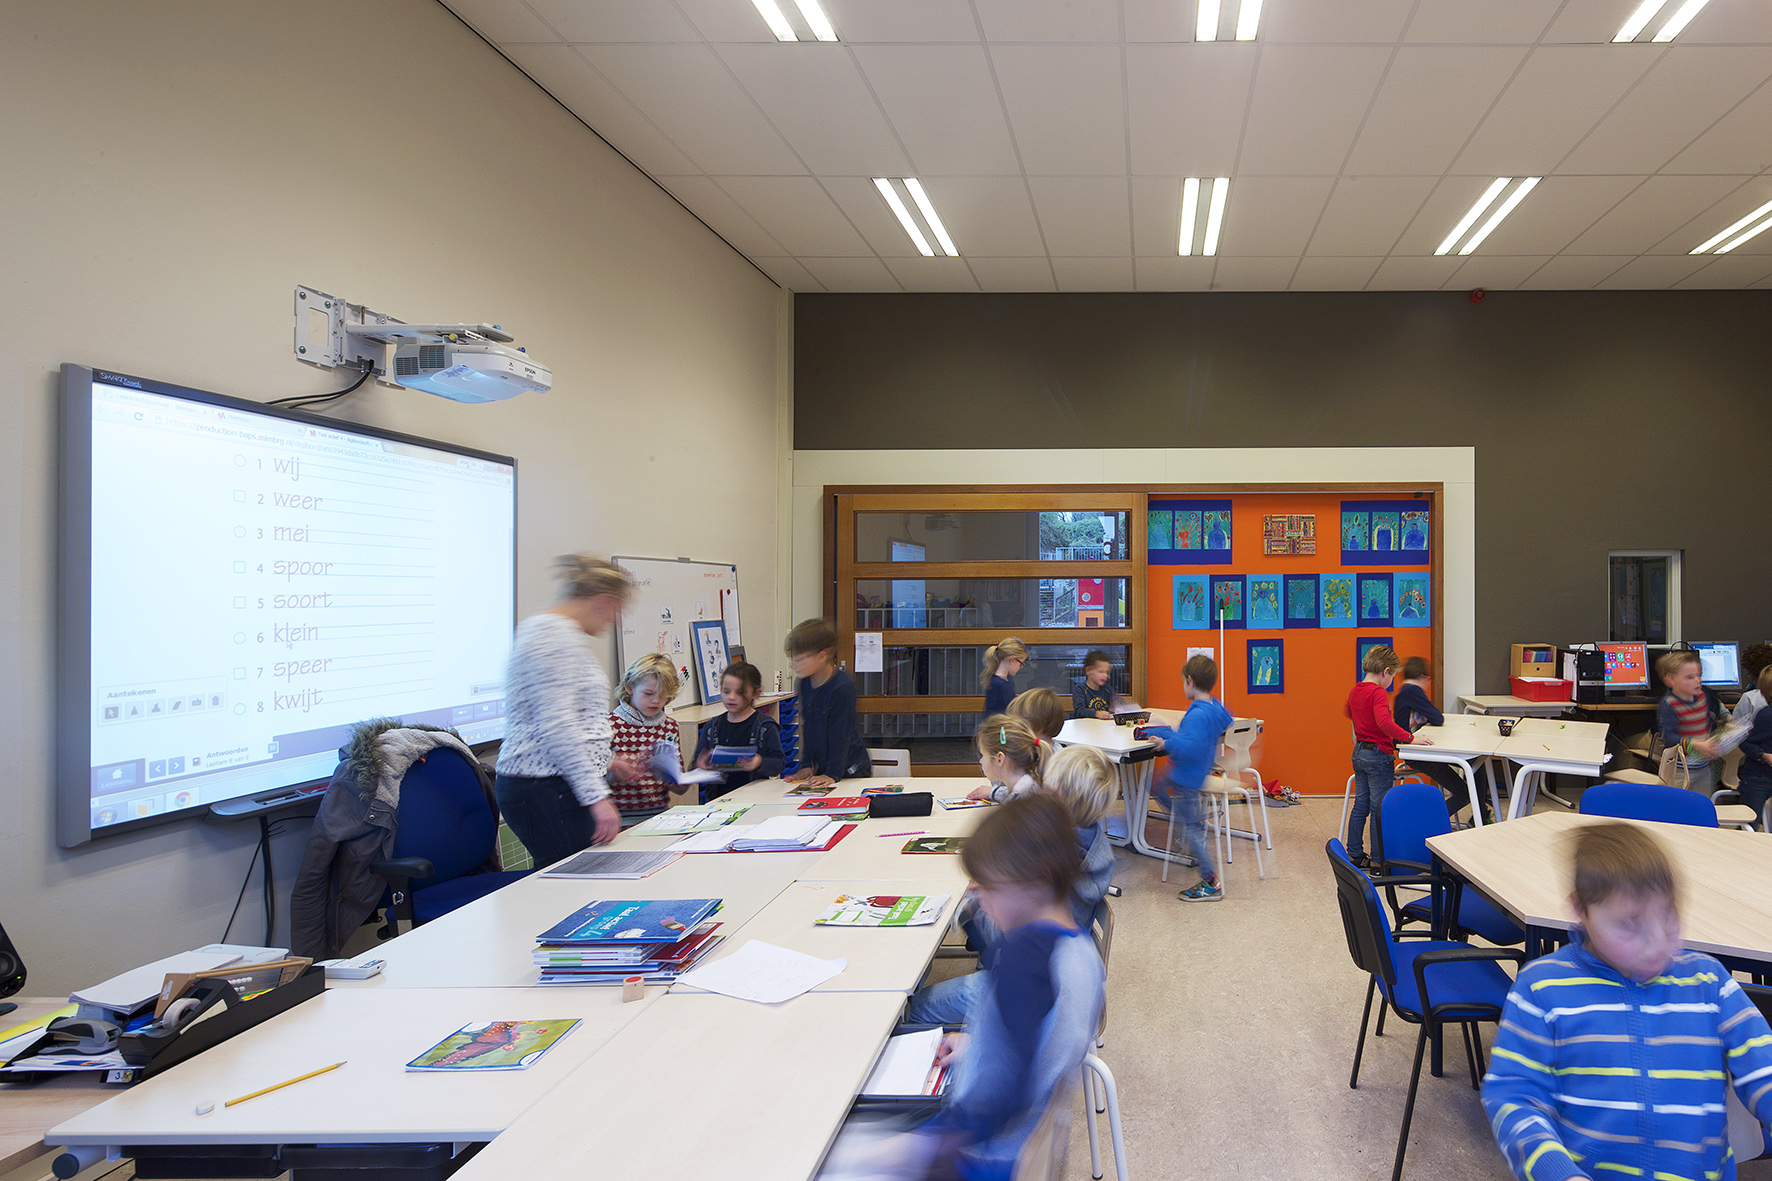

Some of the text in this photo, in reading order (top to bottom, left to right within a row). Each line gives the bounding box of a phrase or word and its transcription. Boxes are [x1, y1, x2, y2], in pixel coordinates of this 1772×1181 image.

[524, 366, 536, 375] EPSON
[256, 456, 300, 482] 1 wij
[257, 491, 323, 510] 2 weer
[256, 524, 309, 542] 3 mei
[256, 560, 333, 583] 4 spoor
[257, 591, 333, 609] 5 soort
[256, 622, 319, 643] 6 klein
[256, 659, 333, 683] 7 speer
[107, 688, 157, 699] Aantekenen
[256, 688, 324, 713] 8 kwijt
[206, 746, 249, 759] Antwoorden
[101, 778, 134, 789] Lesmenu
[621, 905, 640, 917] Taal
[600, 914, 624, 931] actief
